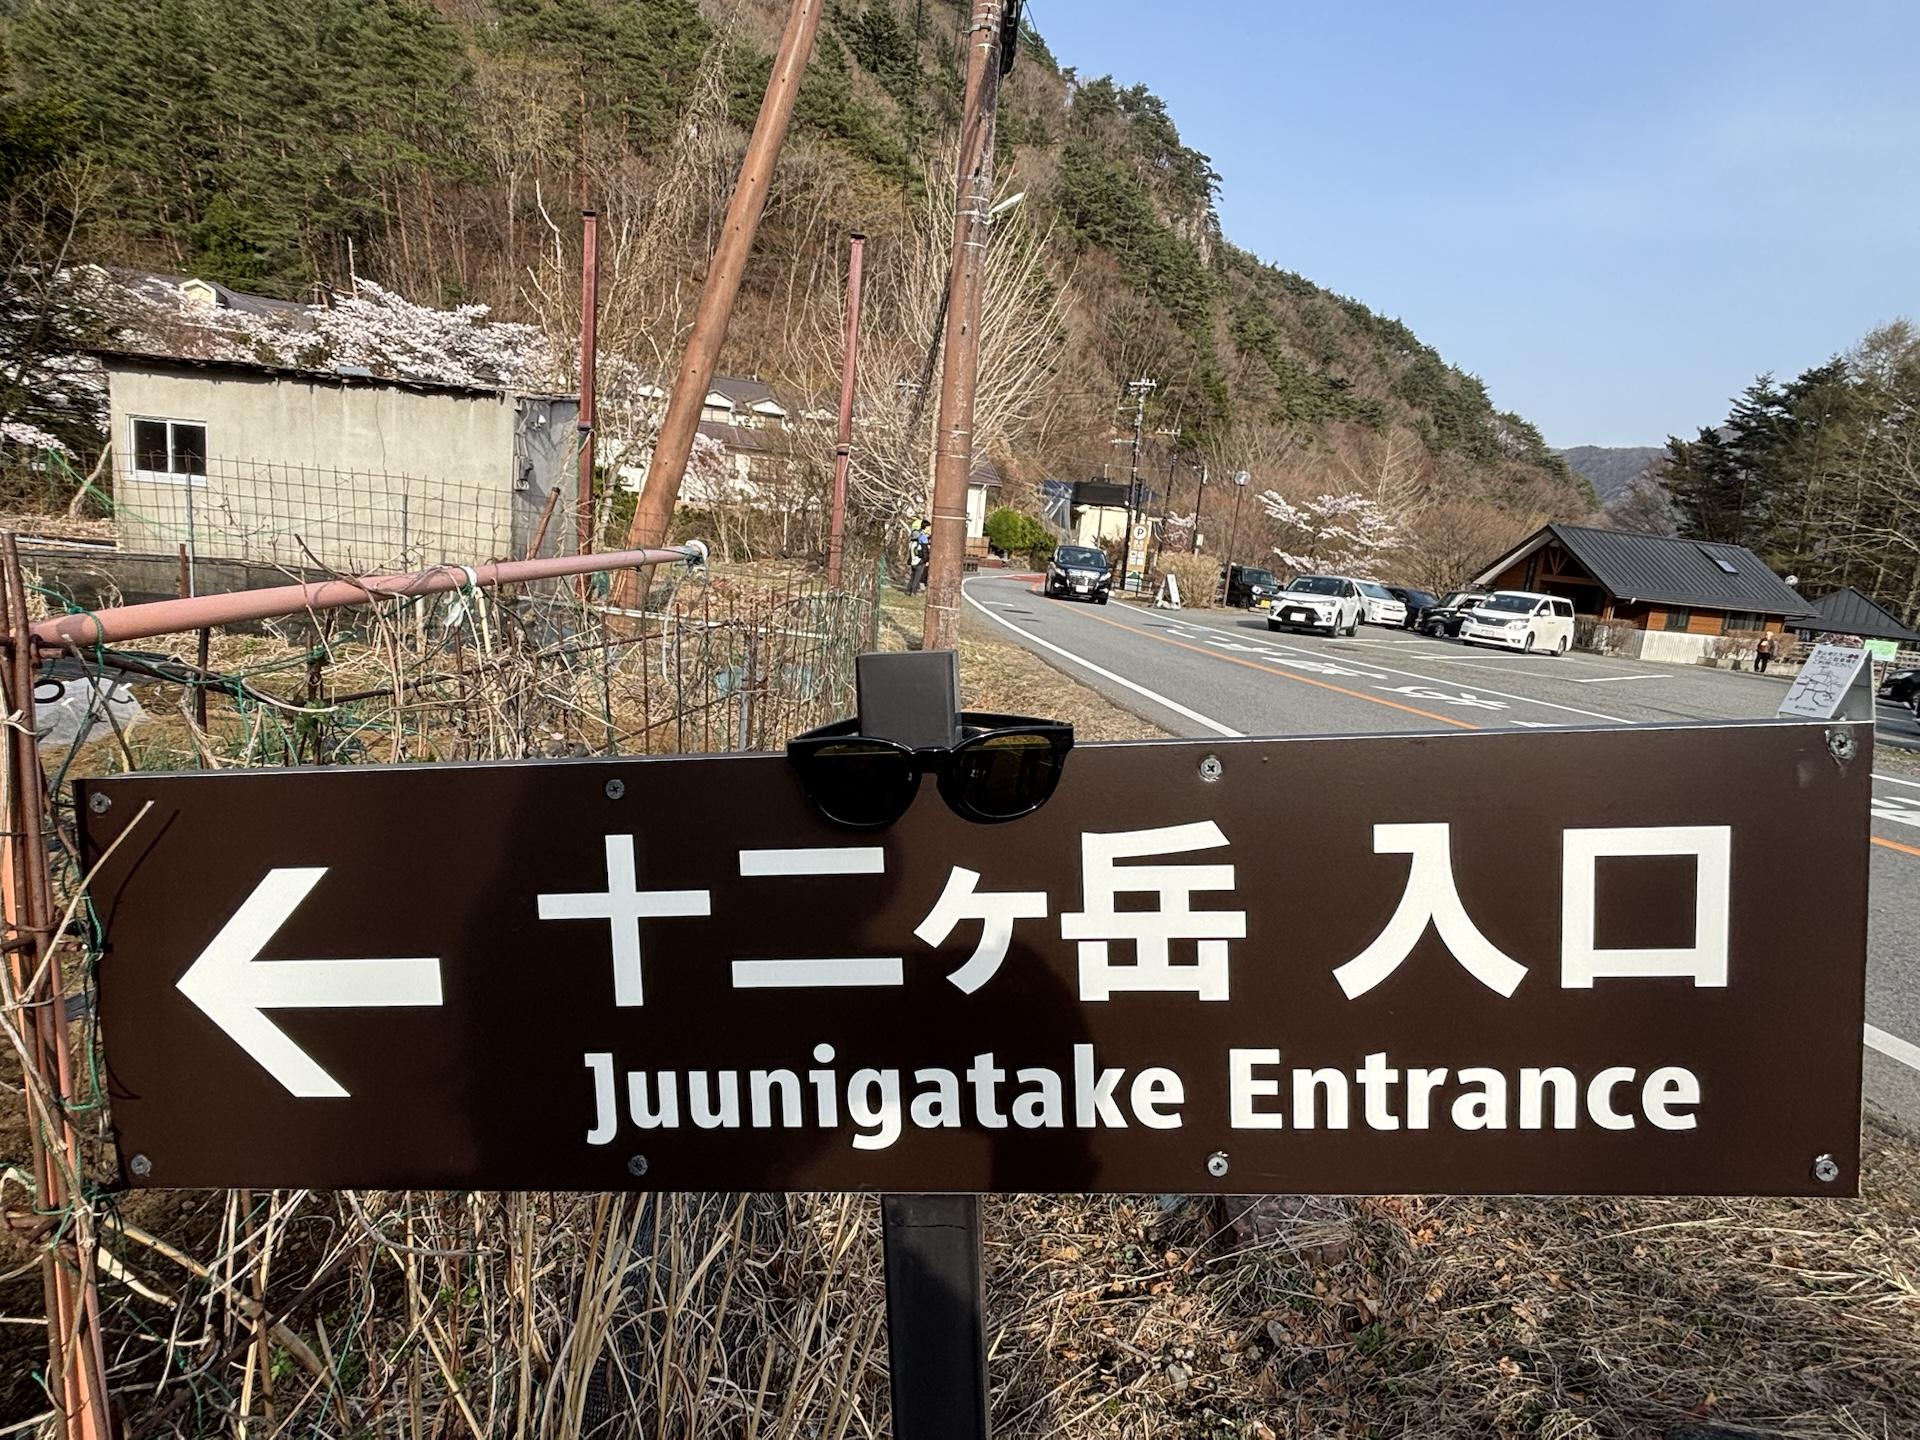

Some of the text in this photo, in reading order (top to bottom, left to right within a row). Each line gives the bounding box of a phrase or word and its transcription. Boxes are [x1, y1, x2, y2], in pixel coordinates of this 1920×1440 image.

[537, 820, 1732, 1007] 十二ヶ岳 入口
[585, 1044, 1701, 1151] Juunigatake Entrance
